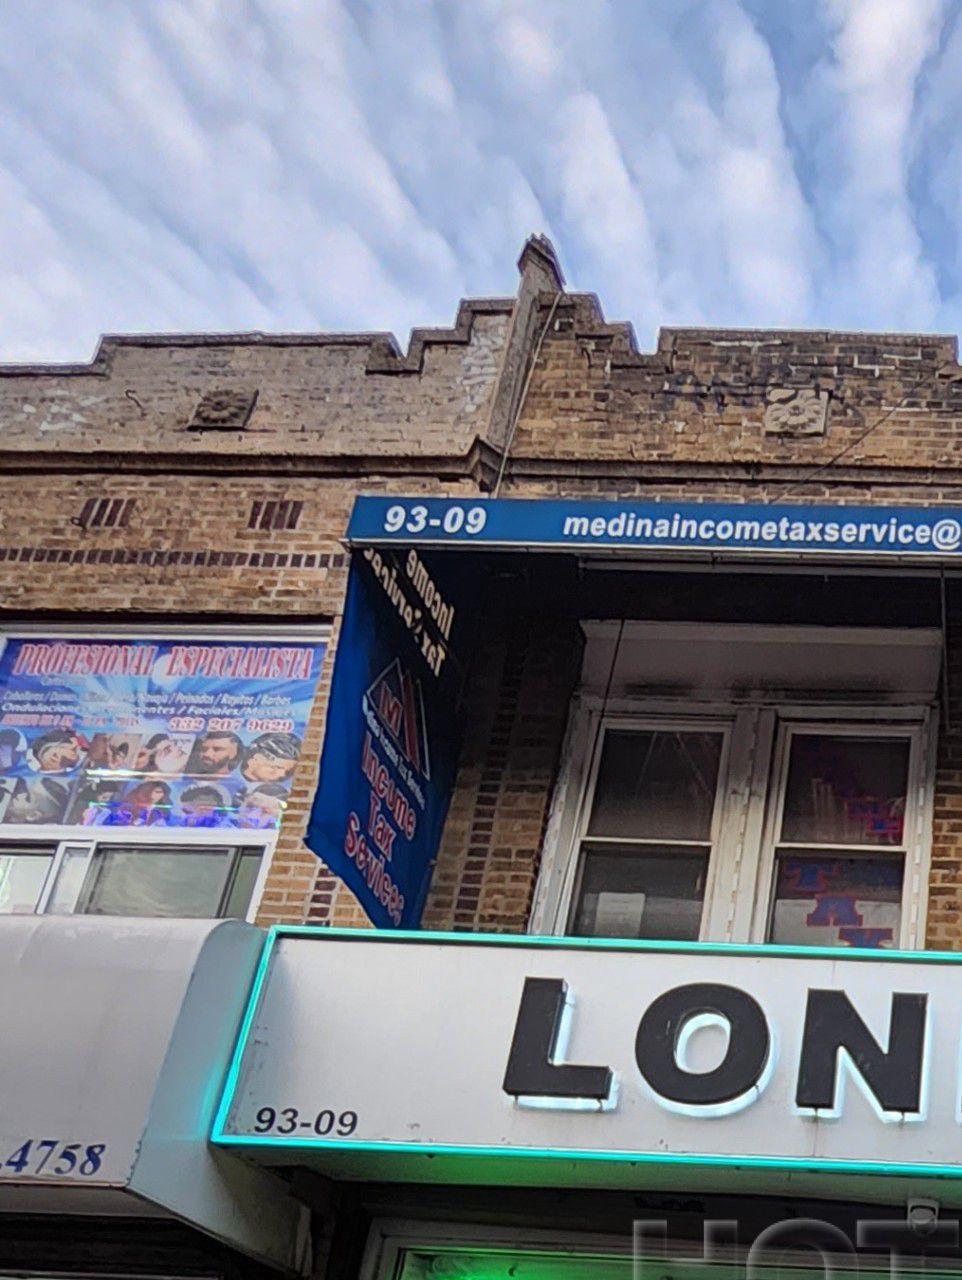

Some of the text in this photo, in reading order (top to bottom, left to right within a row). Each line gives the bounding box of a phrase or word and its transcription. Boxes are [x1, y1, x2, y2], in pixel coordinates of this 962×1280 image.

[384, 506, 487, 535] 93-09
[361, 731, 416, 841] Income
[368, 791, 397, 862] Tax
[345, 811, 405, 927] Services
[254, 1107, 358, 1137] 93-09
